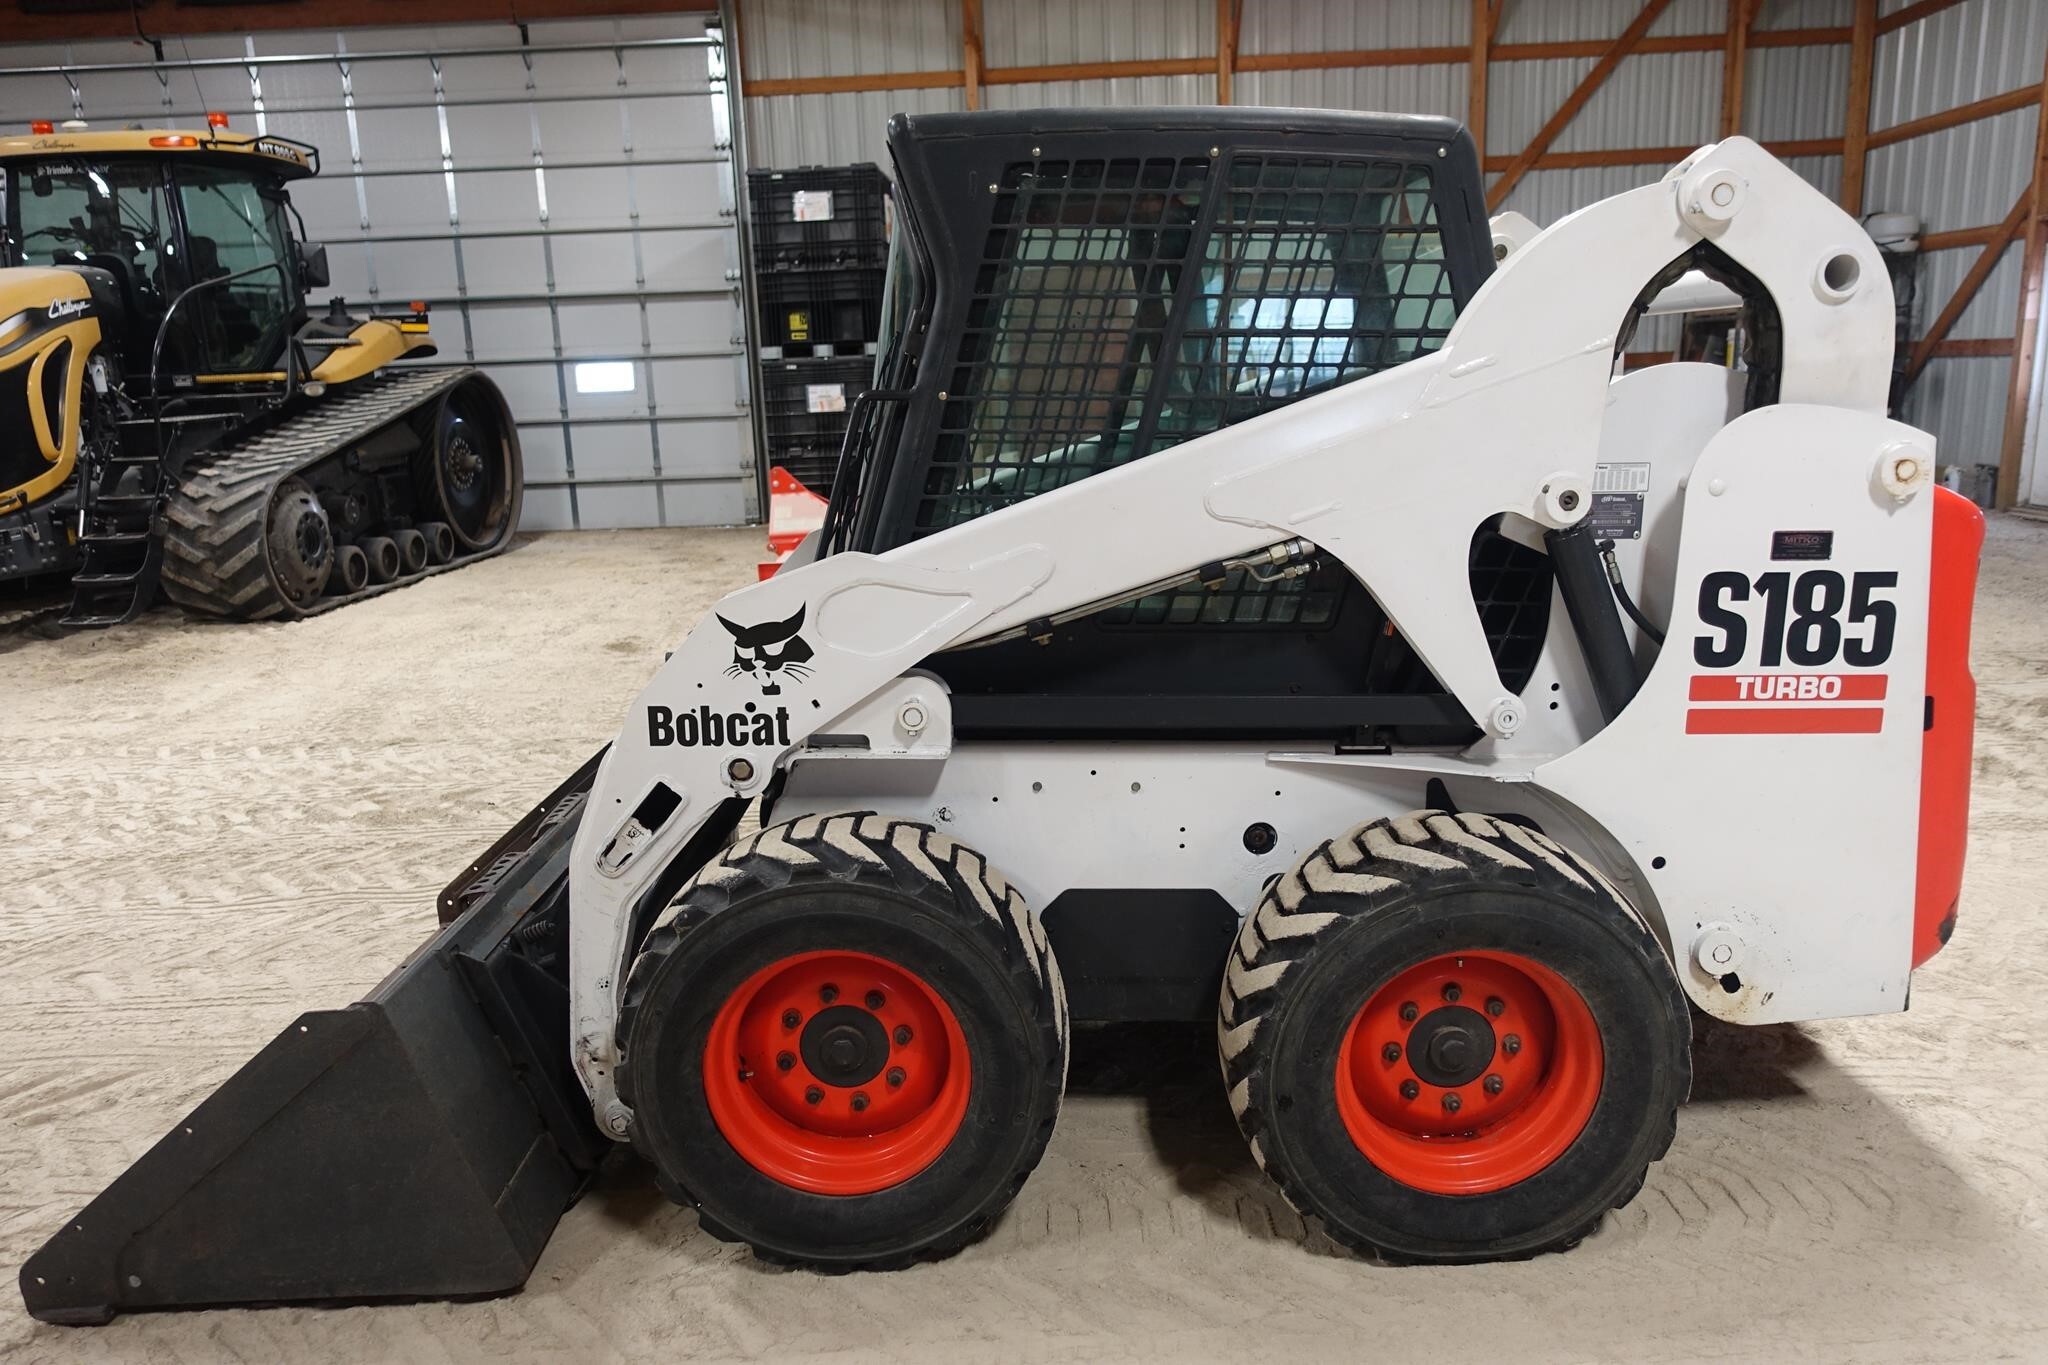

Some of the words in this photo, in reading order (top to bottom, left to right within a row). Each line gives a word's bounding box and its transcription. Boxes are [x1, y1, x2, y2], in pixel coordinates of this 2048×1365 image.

[45, 165, 73, 176] Trimble
[1693, 570, 1899, 668] S185
[1736, 676, 1842, 700] TURBO
[647, 705, 791, 747] Bobcat
